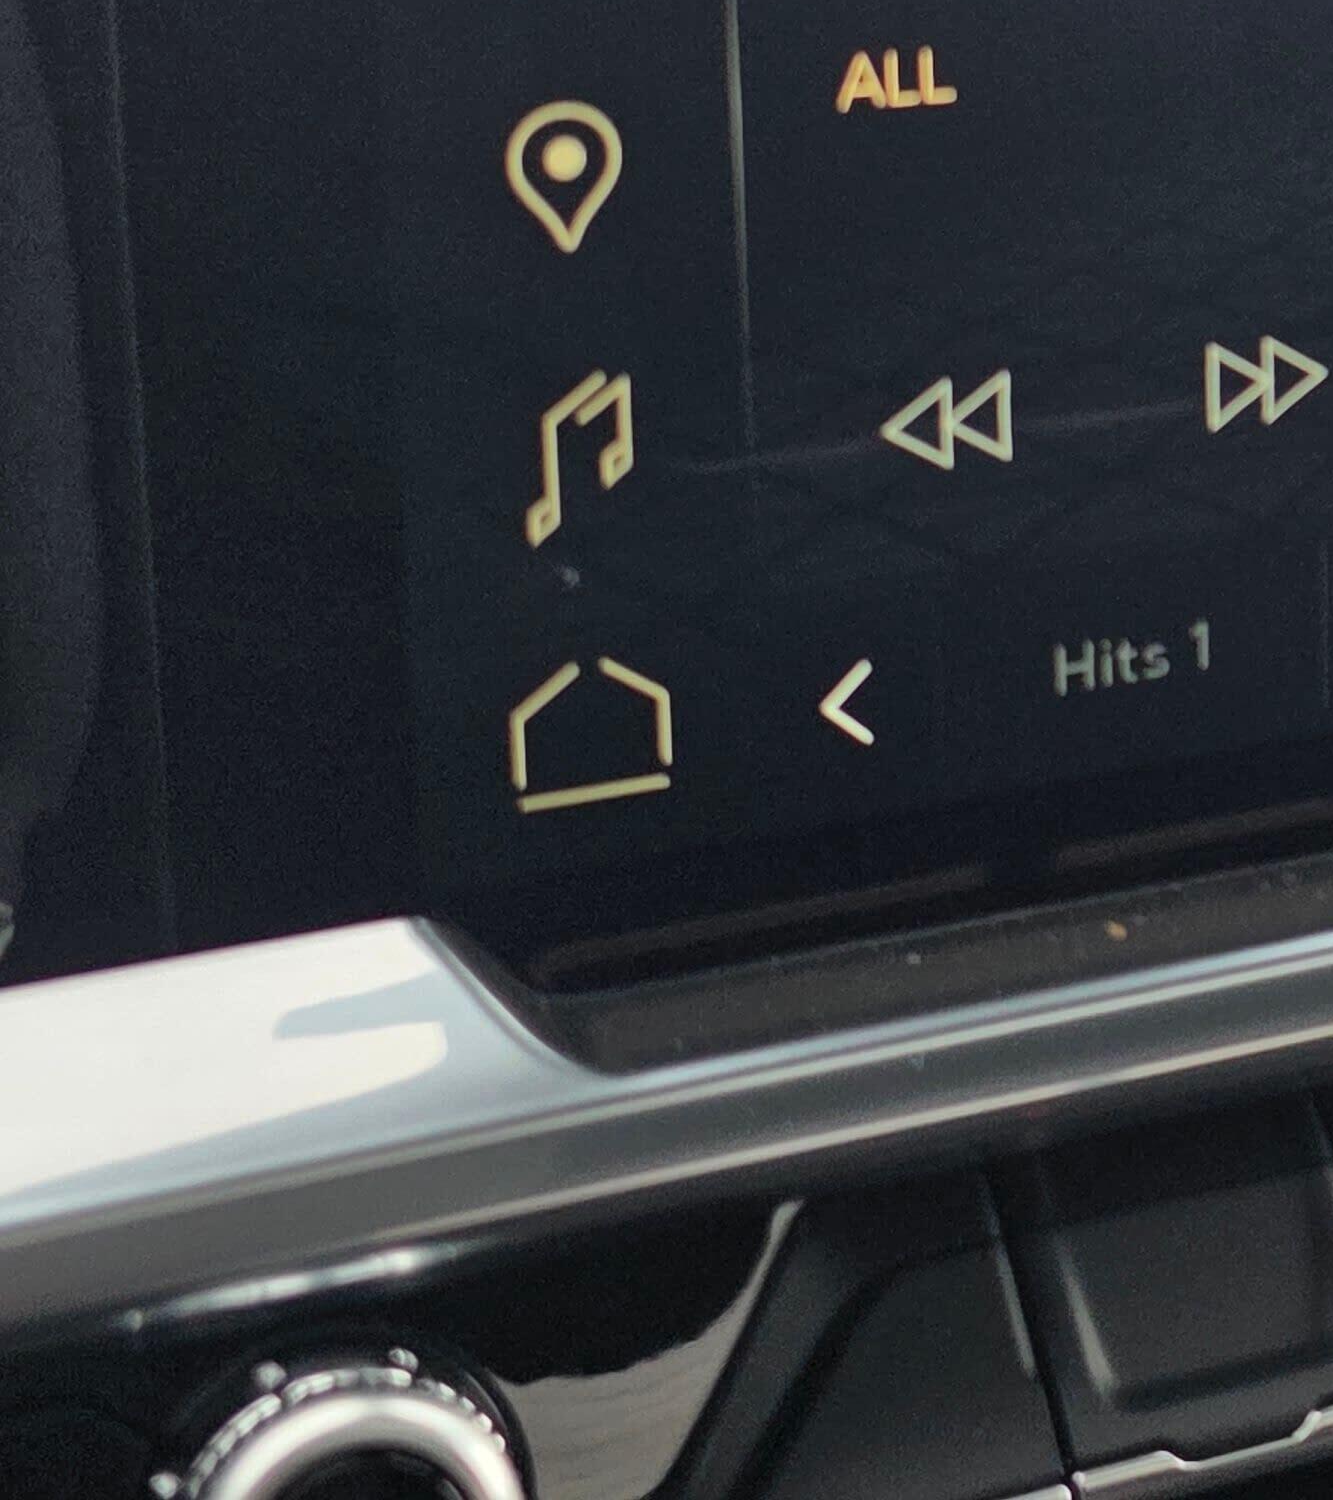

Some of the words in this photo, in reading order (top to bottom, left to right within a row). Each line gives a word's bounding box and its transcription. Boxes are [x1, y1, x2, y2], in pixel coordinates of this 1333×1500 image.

[834, 44, 958, 115] ALL
[1052, 636, 1170, 697] Hits
[1188, 617, 1210, 672] 1
